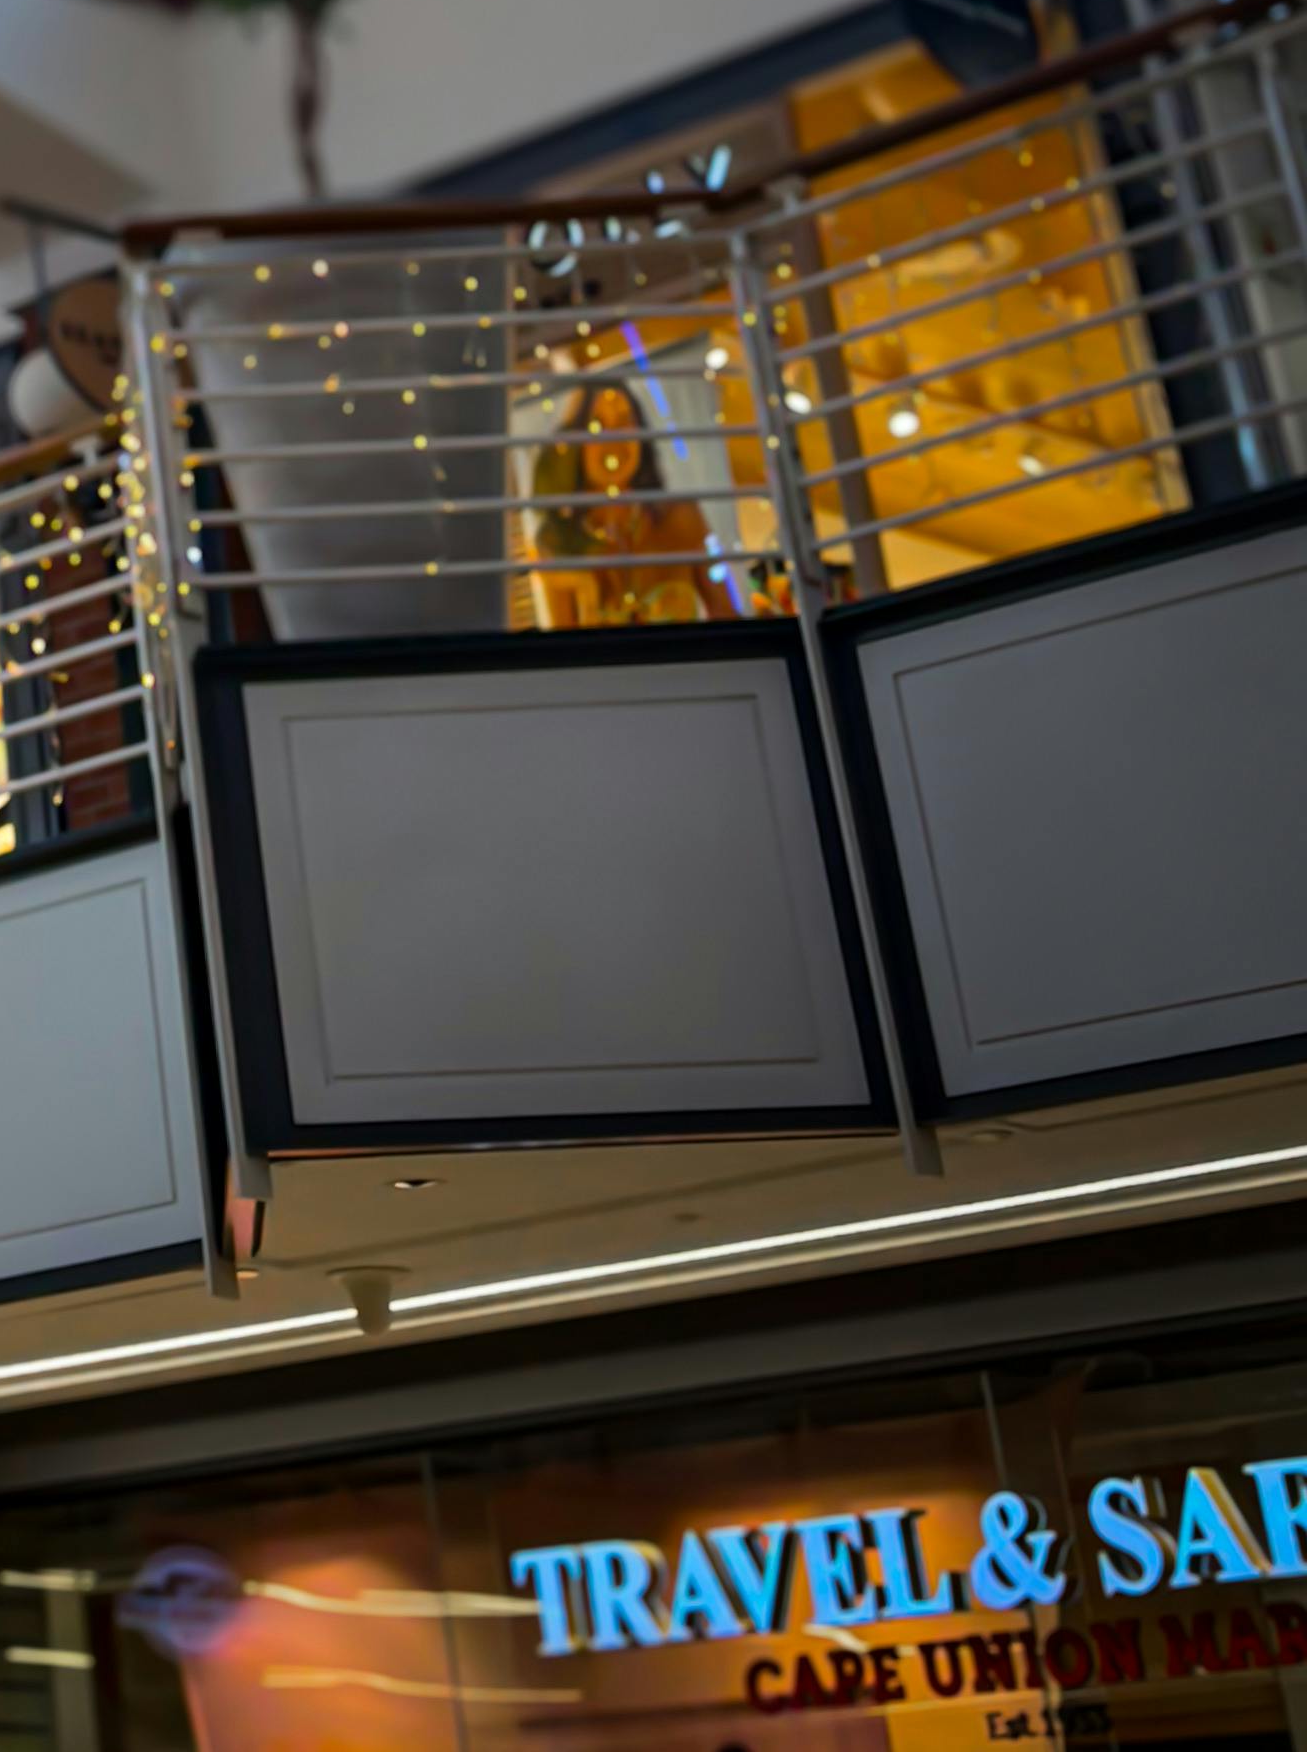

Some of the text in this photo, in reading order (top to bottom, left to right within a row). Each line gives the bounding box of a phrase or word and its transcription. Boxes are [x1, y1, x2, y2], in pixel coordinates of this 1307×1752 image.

[509, 1507, 954, 1656] TRAVEL
[970, 1490, 1066, 1610] &
[746, 1643, 906, 1714] CAPE
[919, 1618, 1145, 1697] UNION
